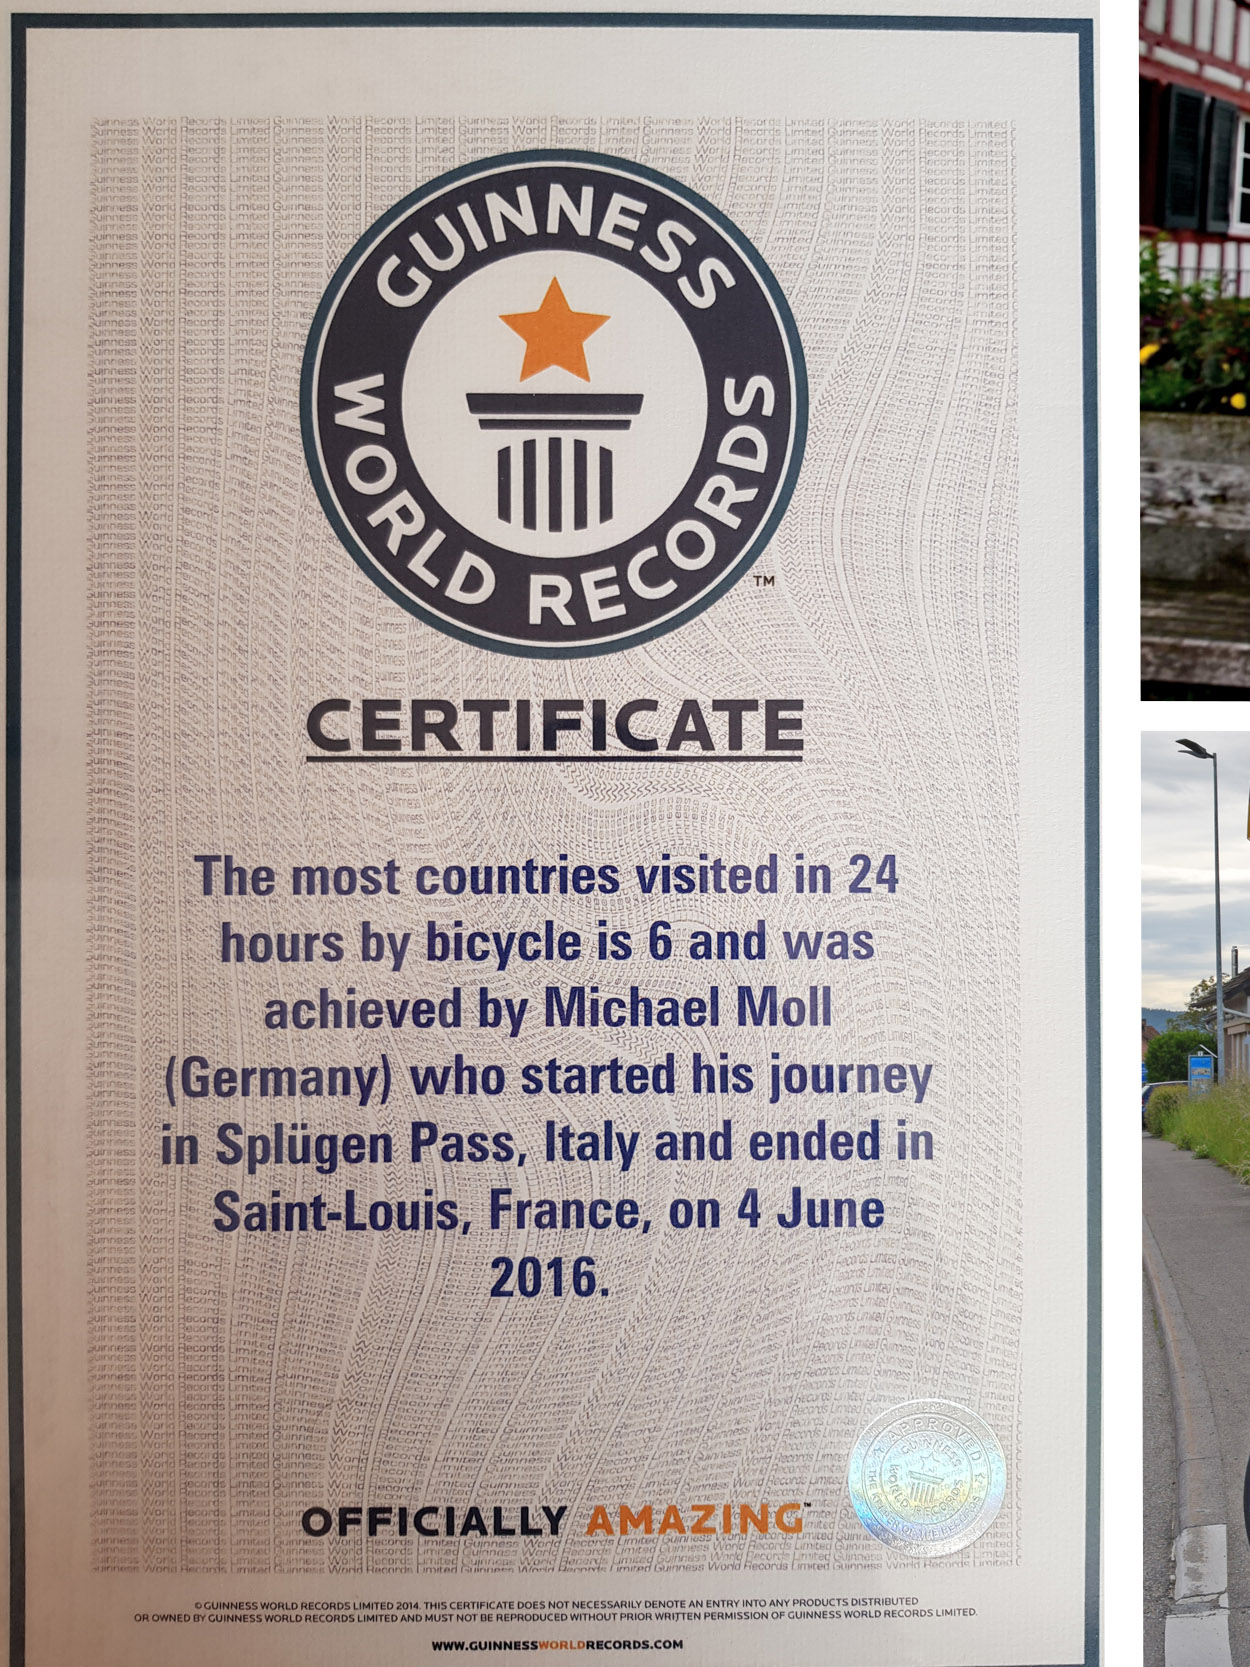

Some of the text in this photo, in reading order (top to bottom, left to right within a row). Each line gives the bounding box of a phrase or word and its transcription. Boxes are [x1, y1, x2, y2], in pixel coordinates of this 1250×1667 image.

[377, 183, 736, 308] GUINNESS
[334, 373, 496, 605] WORLD
[529, 375, 775, 626] RECORDS
[753, 575, 775, 587] TM
[306, 698, 804, 752] CERTIFICATE
[194, 854, 899, 896] The most countries visited in 24
[221, 920, 874, 971] hours by bicycle is 6 and was
[264, 986, 831, 1037] achieved by Michael Moll
[165, 1053, 932, 1107] (Germany) who started his journey
[162, 1120, 934, 1174] in Splügen Pass, Italy and ended in
[213, 1187, 885, 1238] Saint-Louis, France, on 4 June
[490, 1256, 609, 1299] 2016.
[888, 1417, 983, 1462] APPROVED
[900, 1438, 963, 1468] GUINNESS
[868, 1470, 878, 1491] THE
[889, 1463, 910, 1508] WORLD
[302, 1505, 568, 1537] OFFICIALLY
[585, 1502, 803, 1537] AMAZING
[134, 1608, 978, 1623] OR OWNED BY GUINNESS WORLD RECORDS LIMITED AND MUST NOT BE REPRODUCED WITHOUT PRIOR WRITTEN PERMISSION OF GUINNESS WORLD RECORDS LIMITED.
[260, 1601, 299, 1611] WORLD
[301, 1601, 352, 1611] RECORDS
[353, 1601, 394, 1611] LIMITED
[396, 1601, 422, 1611] 2014.
[424, 1601, 448, 1611] THIS
[449, 1601, 515, 1610] CERTIFICATE
[517, 1601, 546, 1610] DOES
[548, 1600, 570, 1610] NOT
[572, 1600, 642, 1610] NECESSARILY
[644, 1600, 685, 1609] DENOTE
[688, 1600, 703, 1609] AN
[706, 1600, 740, 1609] ENTRY
[742, 1599, 766, 1608] INTO
[769, 1599, 790, 1608] ANY
[792, 1598, 849, 1608] PRODUCTS
[851, 1597, 919, 1607] DISTRIBUTED
[432, 1639, 684, 1651] WWW.GUINNESSWORLDRECORDS.COM
